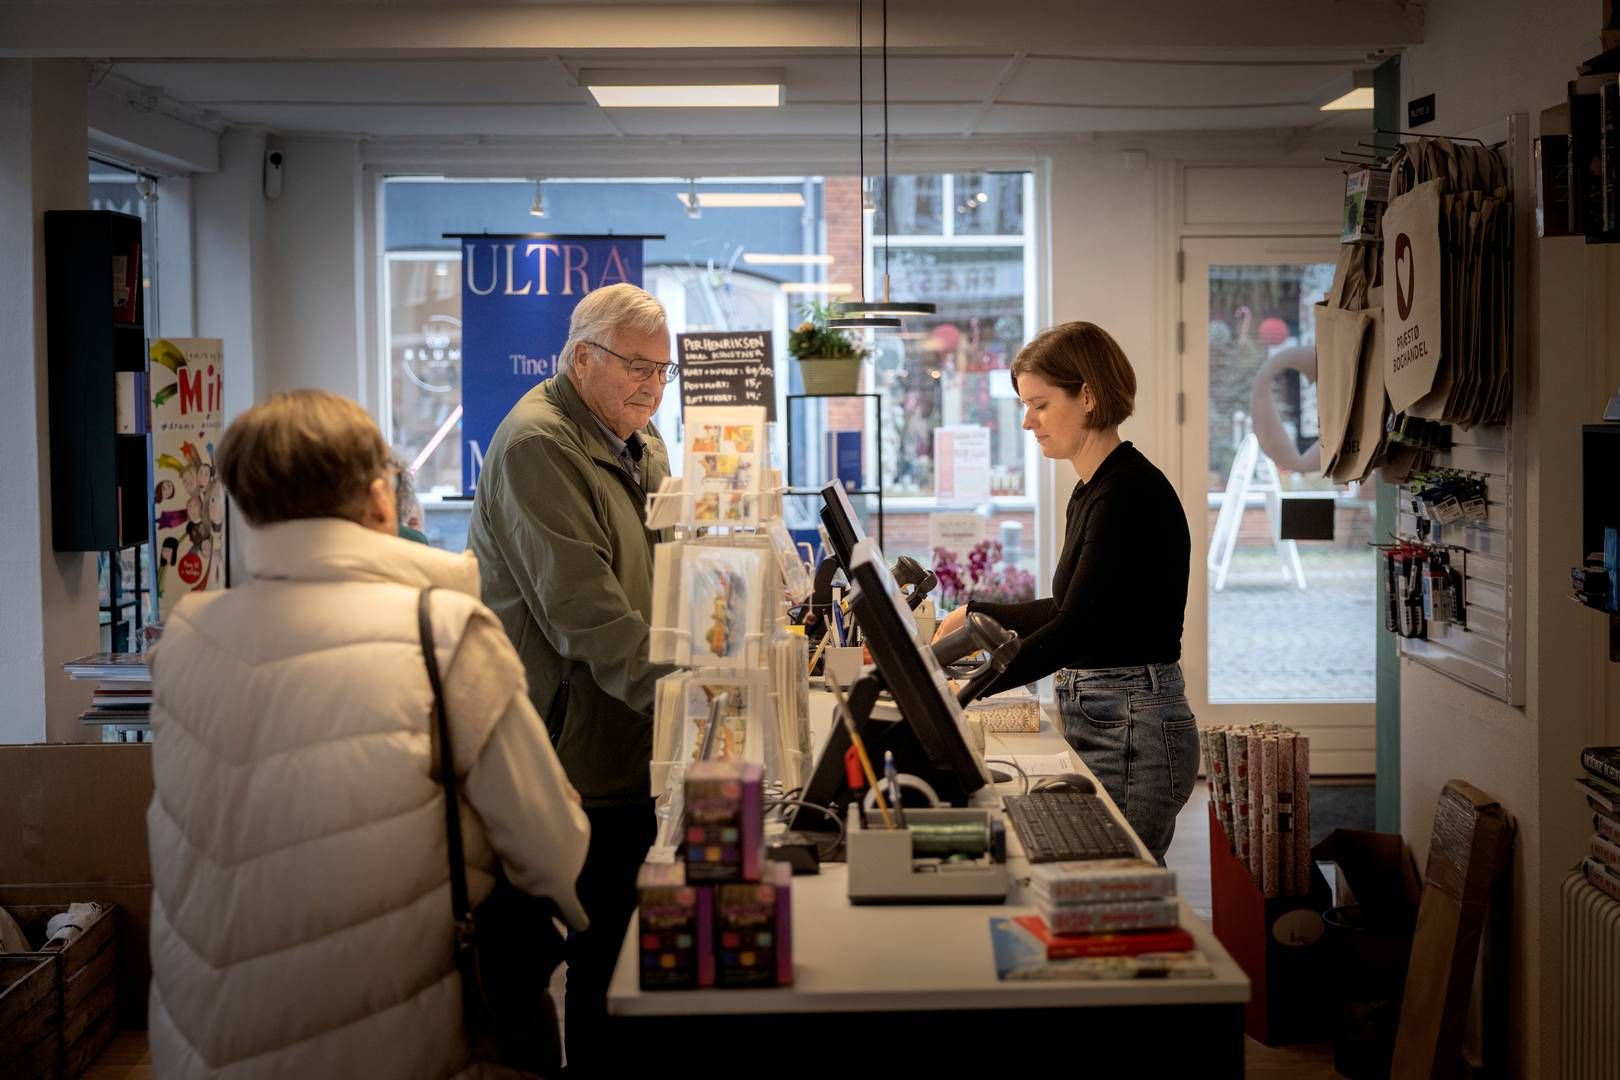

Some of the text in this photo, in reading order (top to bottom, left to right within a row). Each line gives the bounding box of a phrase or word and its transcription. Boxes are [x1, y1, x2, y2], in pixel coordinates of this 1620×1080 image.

[466, 243, 630, 296] ULTRA
[683, 335, 765, 351] PER HENRIKSEN
[1396, 324, 1420, 352] PRÆSTØ
[508, 354, 548, 376] Tine
